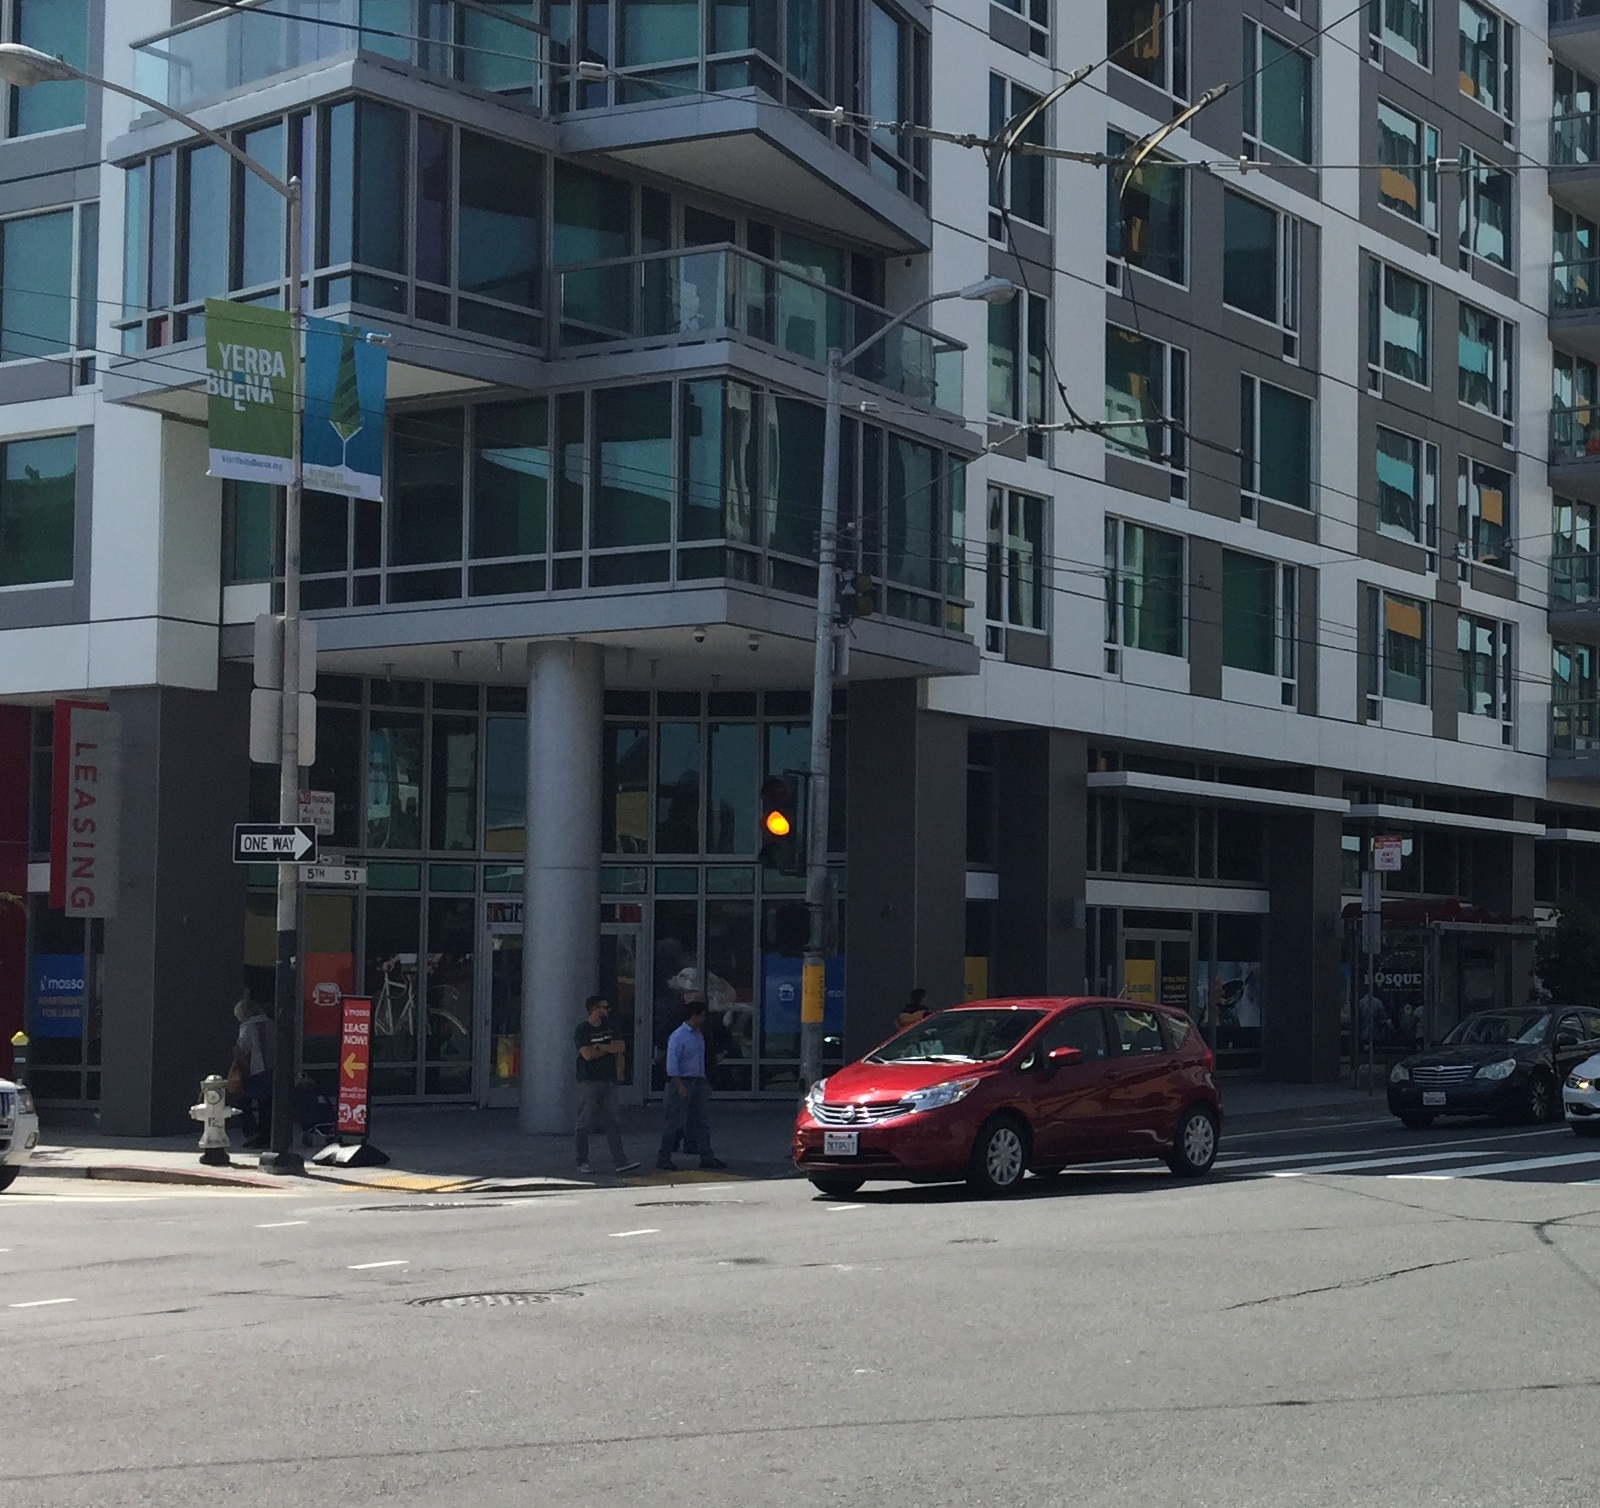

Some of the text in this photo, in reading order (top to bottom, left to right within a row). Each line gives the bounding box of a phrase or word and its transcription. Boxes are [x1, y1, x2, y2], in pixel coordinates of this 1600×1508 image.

[218, 342, 287, 379] YERBA
[206, 367, 274, 411] BUENA
[70, 741, 98, 910] LEASING
[243, 836, 295, 851] ONE WAY
[307, 868, 359, 881] 5TH ST
[48, 979, 84, 990] mosso
[344, 1023, 369, 1033] LEASE
